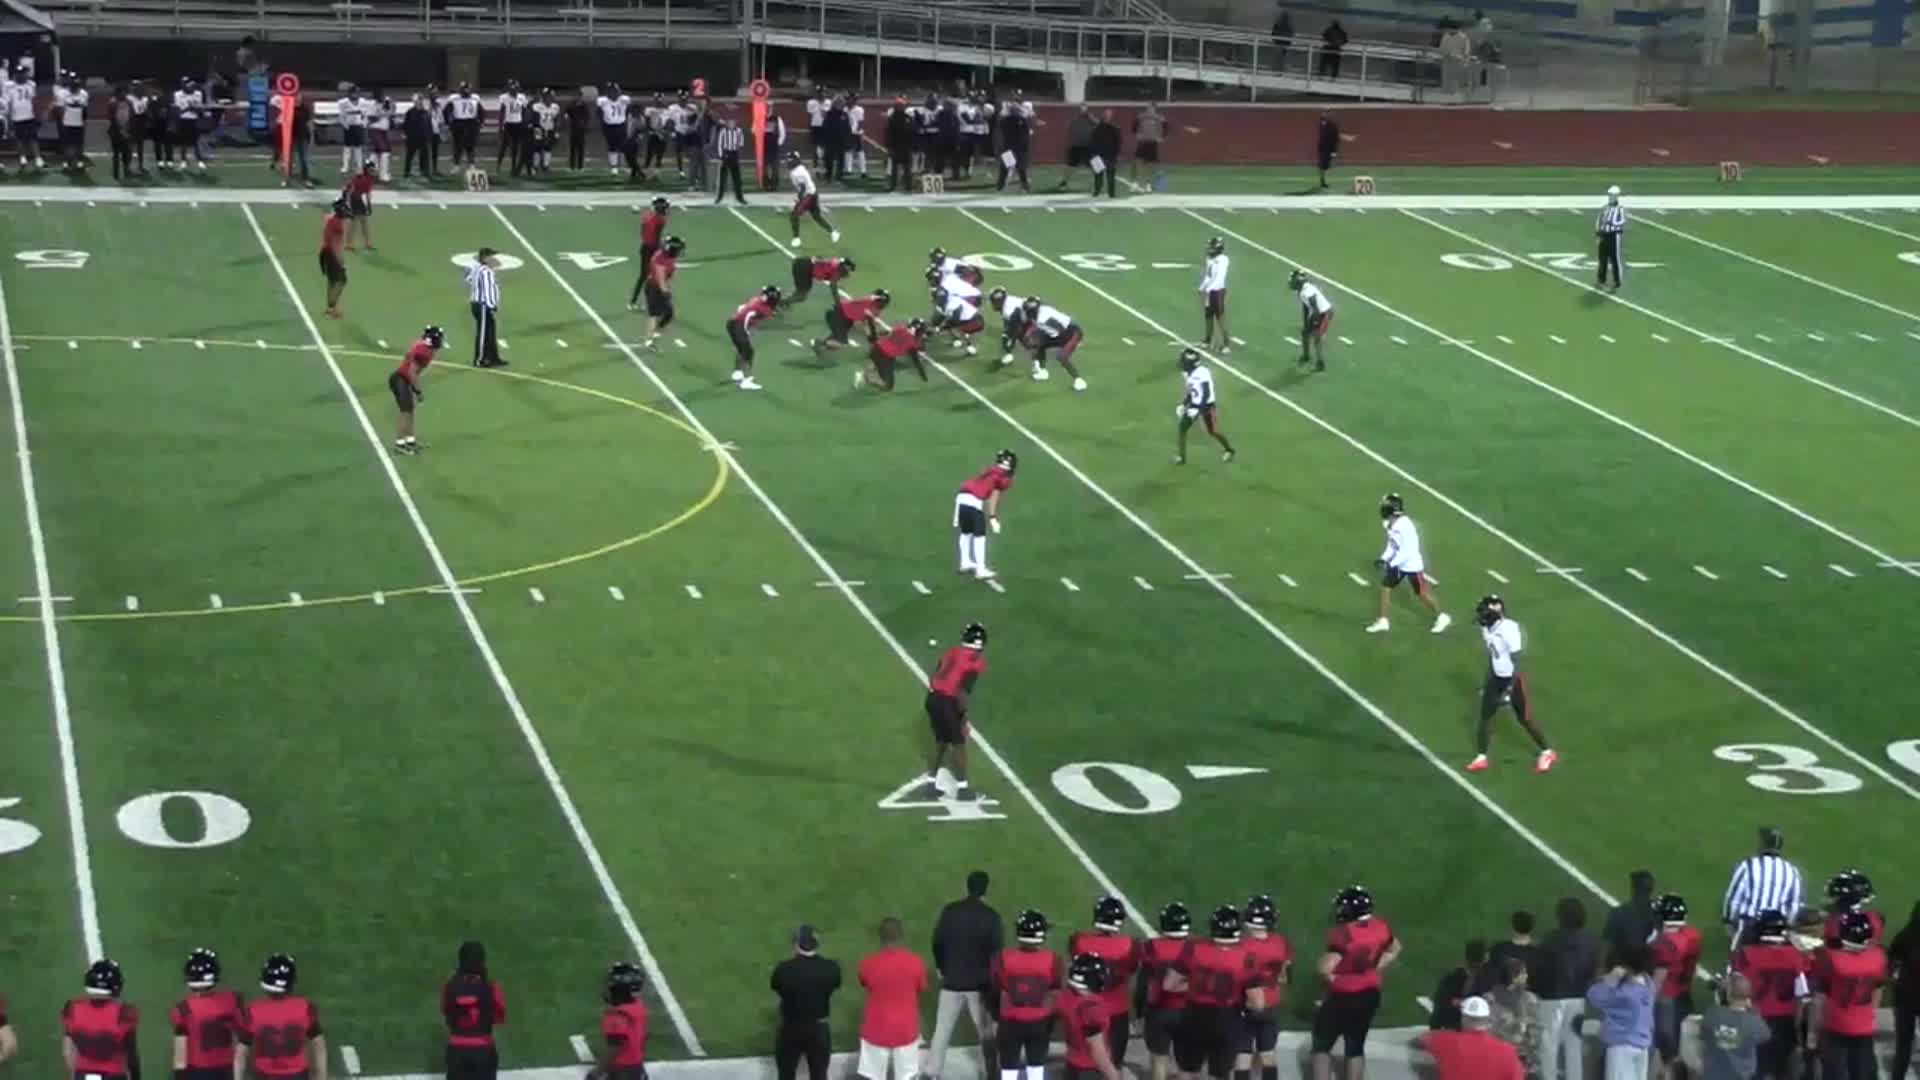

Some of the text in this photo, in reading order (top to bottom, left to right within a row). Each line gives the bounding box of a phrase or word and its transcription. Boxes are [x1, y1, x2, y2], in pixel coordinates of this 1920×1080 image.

[693, 78, 705, 95] 2
[470, 172, 488, 191] 40
[925, 177, 942, 193] 30
[1357, 179, 1373, 195] 20
